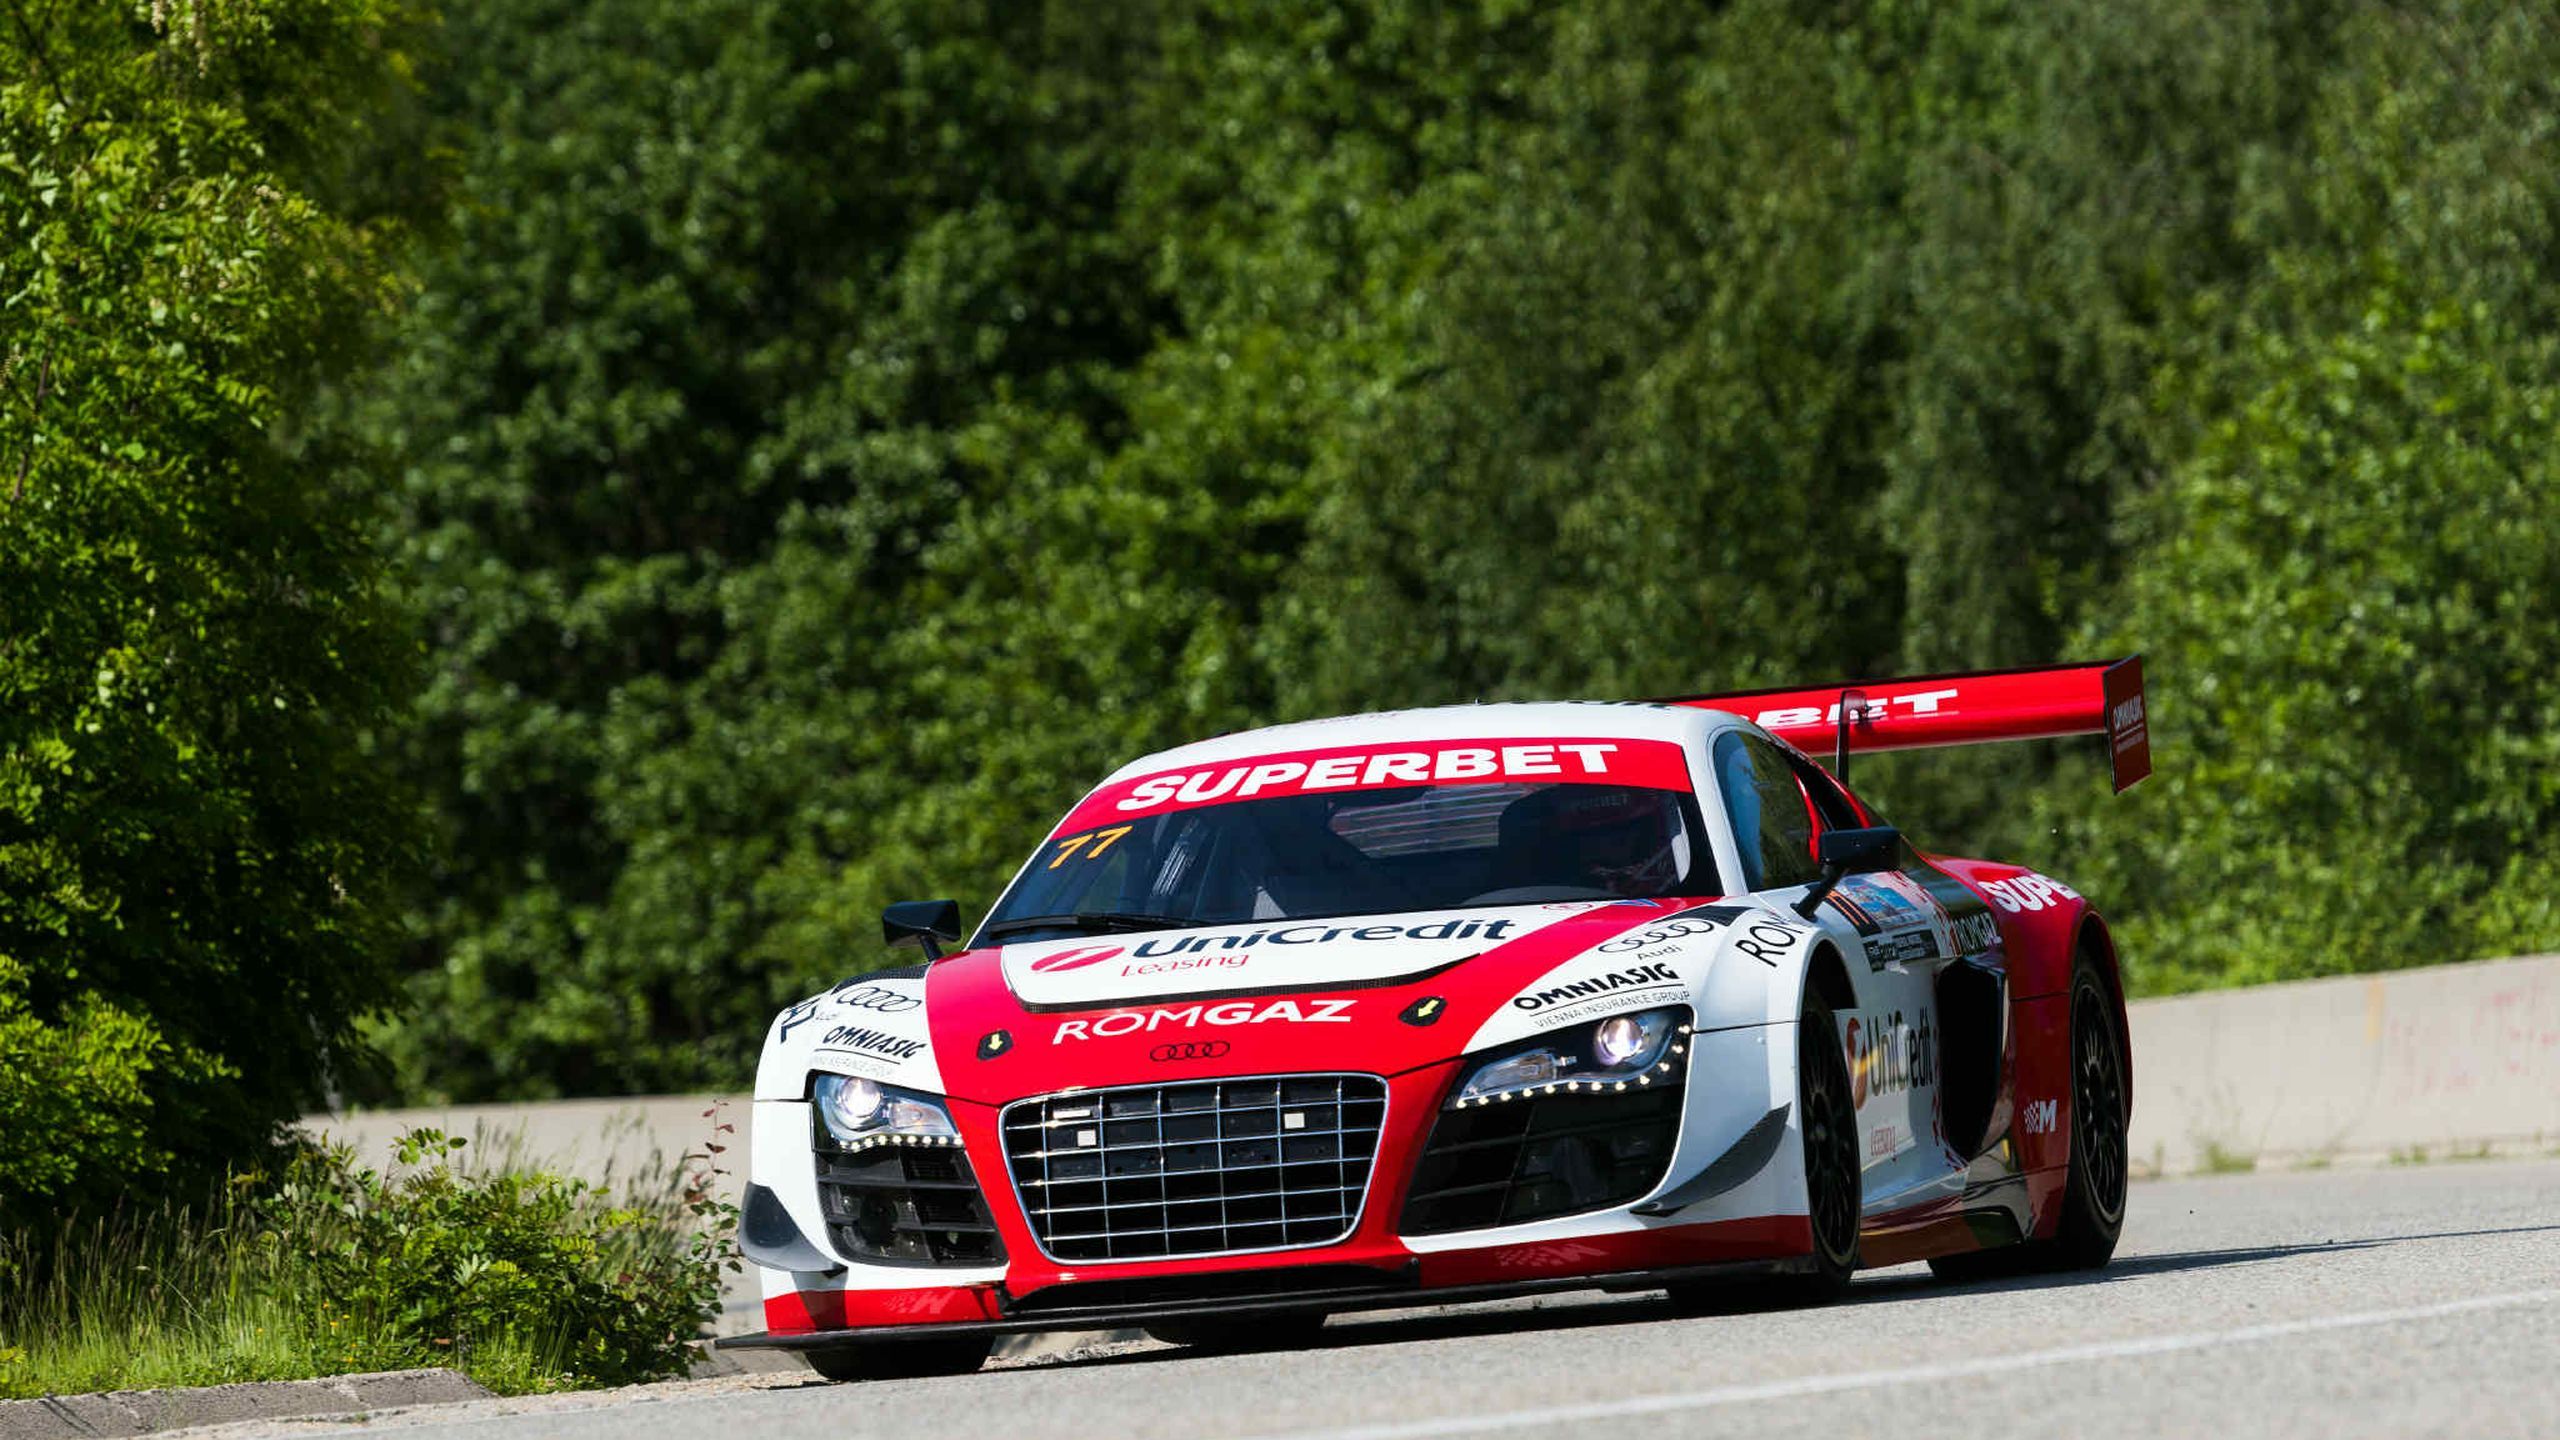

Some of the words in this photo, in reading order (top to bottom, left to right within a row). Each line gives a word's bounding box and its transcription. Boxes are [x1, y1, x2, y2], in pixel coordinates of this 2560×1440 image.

[1116, 744, 1617, 811] SUPERBET
[1048, 826, 1133, 870] 77
[1133, 918, 1516, 958] UniCredit
[1637, 944, 1683, 961] Audi
[1120, 953, 1249, 977] Leasing
[1513, 962, 1680, 1011] OMNIASIG
[1052, 999, 1358, 1045] ROMGAZ
[1535, 1010, 1584, 1028] VIENNA
[1583, 994, 1651, 1015] INSURANCE
[1652, 989, 1691, 1003] GROUP
[822, 1025, 928, 1059] OMNIASIG
[1866, 1006, 1933, 1096] UniCredit
